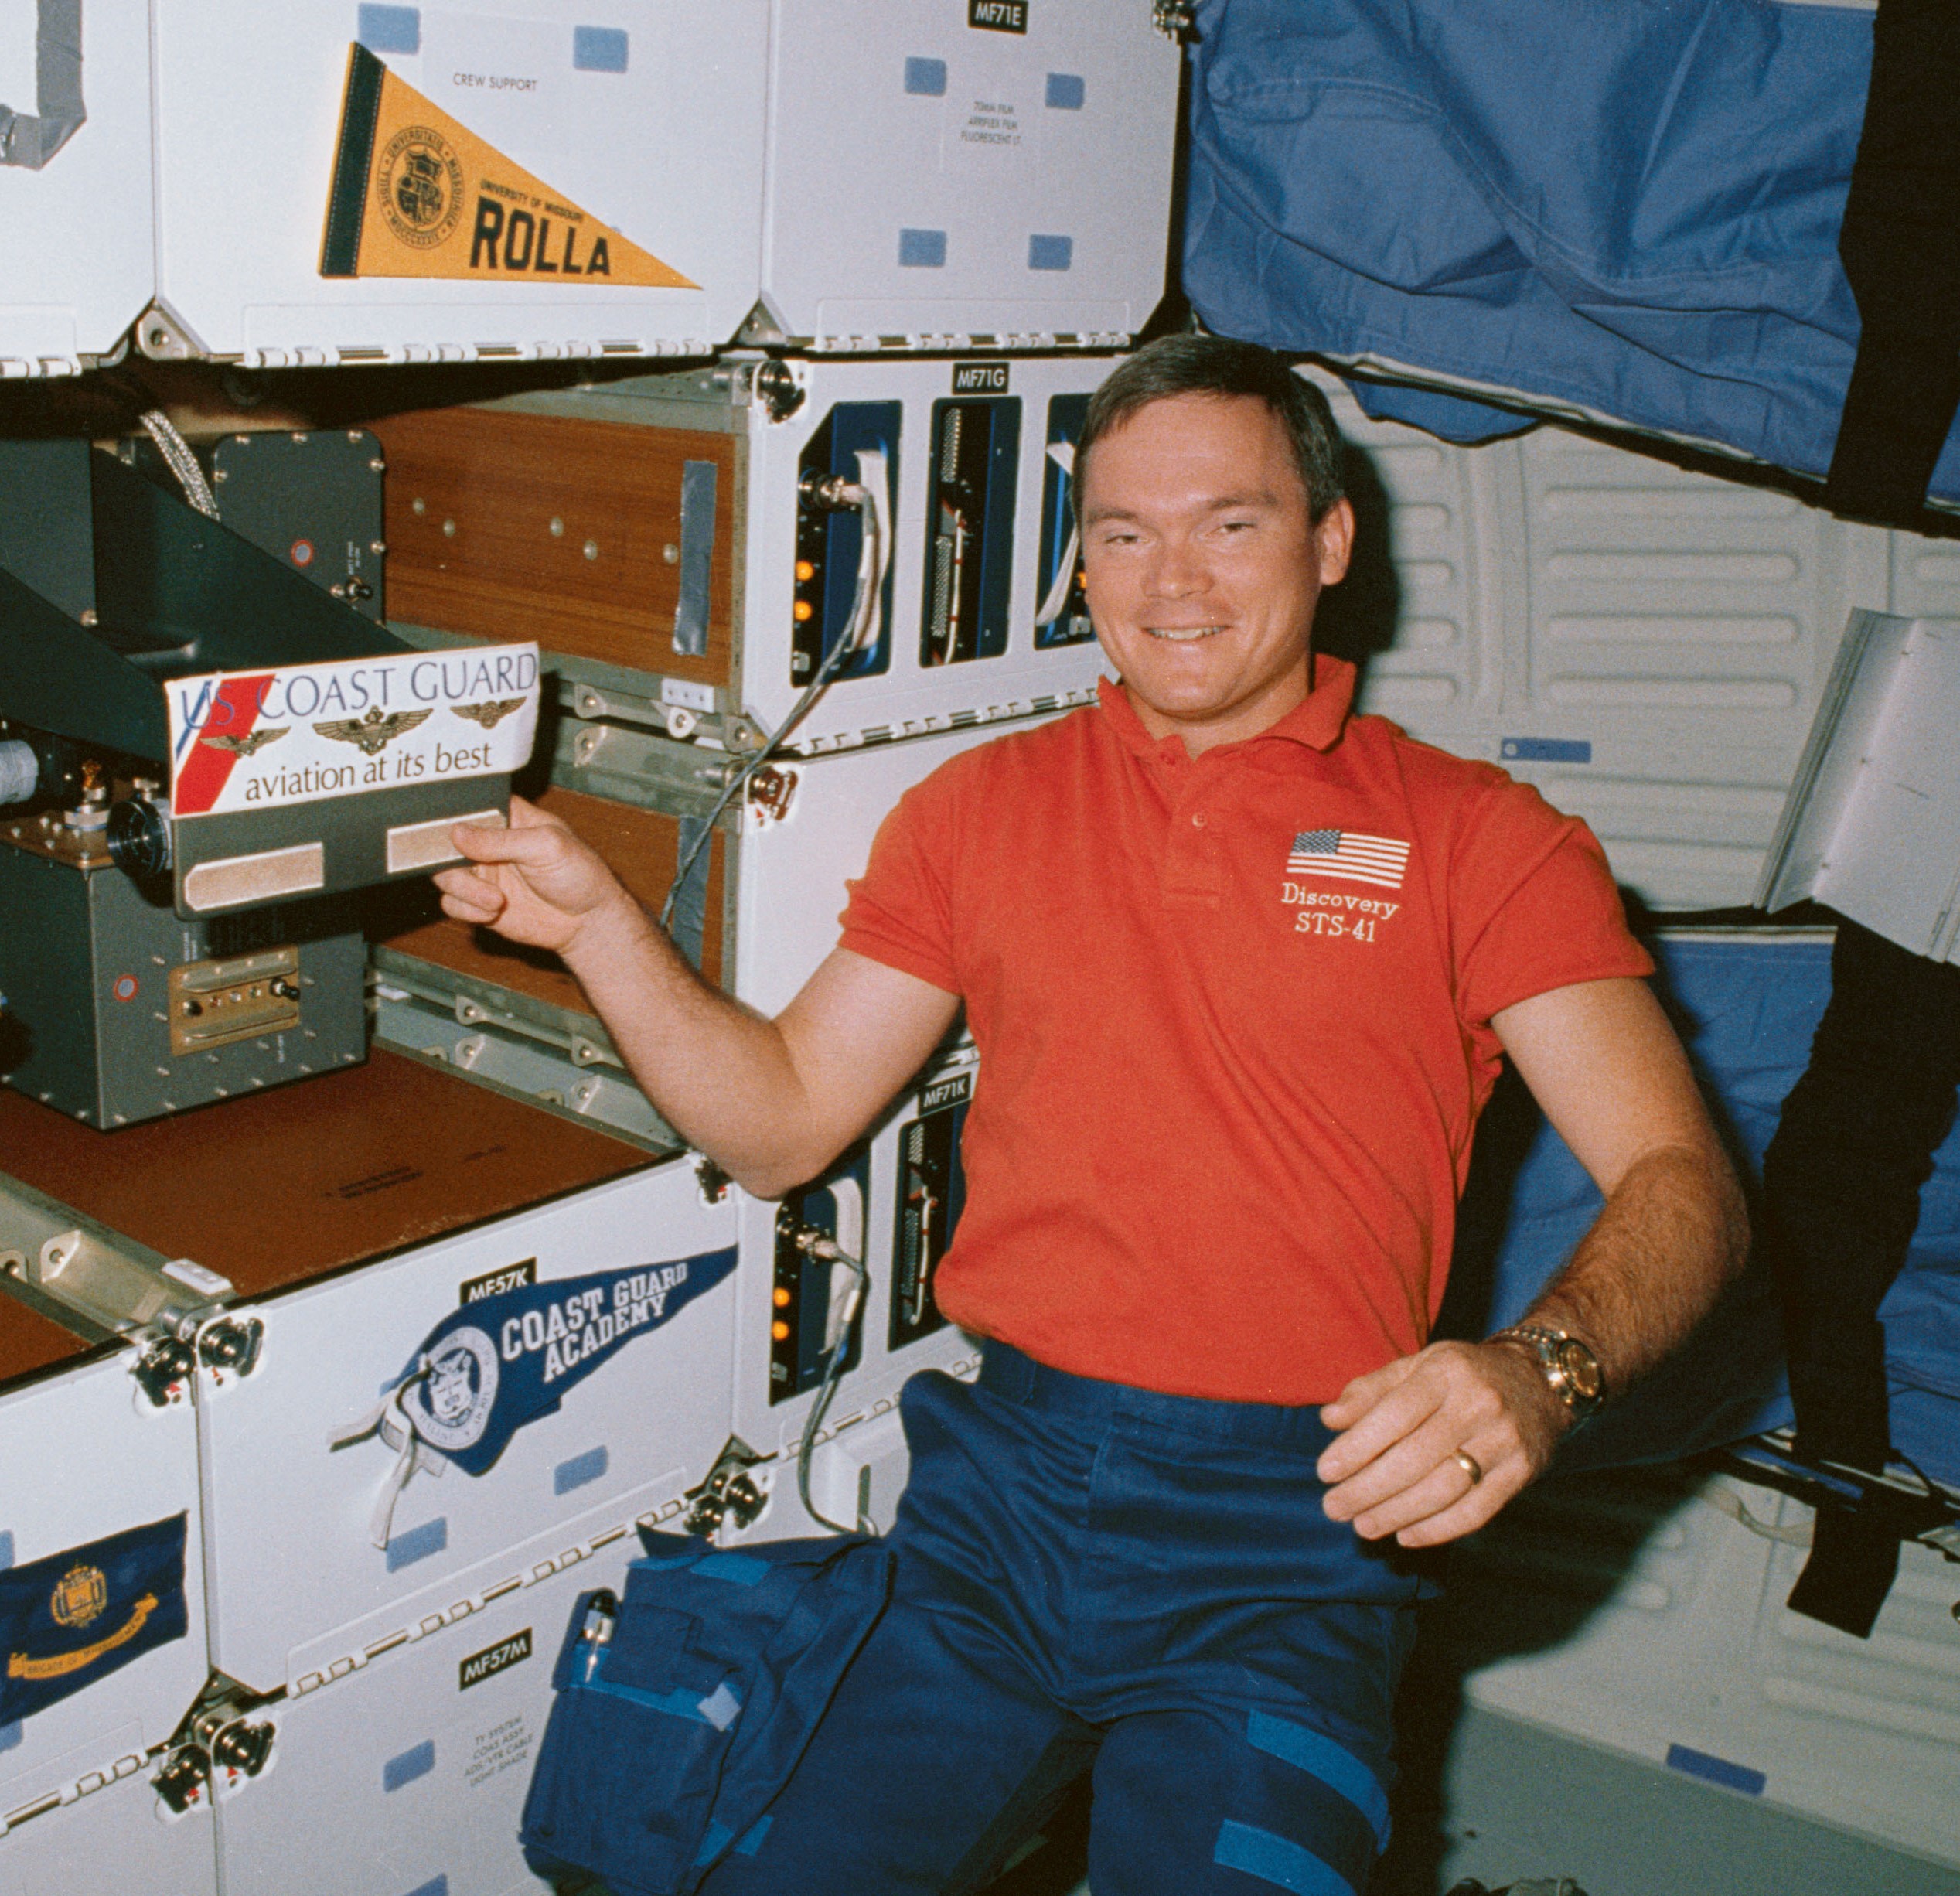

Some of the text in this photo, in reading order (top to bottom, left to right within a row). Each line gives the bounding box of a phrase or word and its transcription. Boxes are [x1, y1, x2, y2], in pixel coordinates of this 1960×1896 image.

[975, 2, 1021, 26] MF71E
[452, 73, 537, 91] CREW SUPPORT
[960, 129, 1011, 145] FLUORESCENT
[481, 179, 528, 204] UNIVERSITY
[531, 196, 541, 208] OF
[469, 195, 611, 276] ROLLA
[956, 368, 1005, 388] MF71G
[182, 652, 538, 731] US COAST GUARD
[245, 741, 493, 802] aviation at its best
[1281, 882, 1399, 920] Discovery
[1294, 911, 1375, 943] STS-41
[924, 1078, 966, 1108] MF71K
[468, 1267, 528, 1303] MF57K
[502, 1262, 688, 1362] COAST GUARD
[544, 1291, 667, 1383] ACADEMY
[465, 1637, 527, 1683] MF57M
[489, 1716, 522, 1739] SYSTEM
[506, 1731, 533, 1754] CABLE
